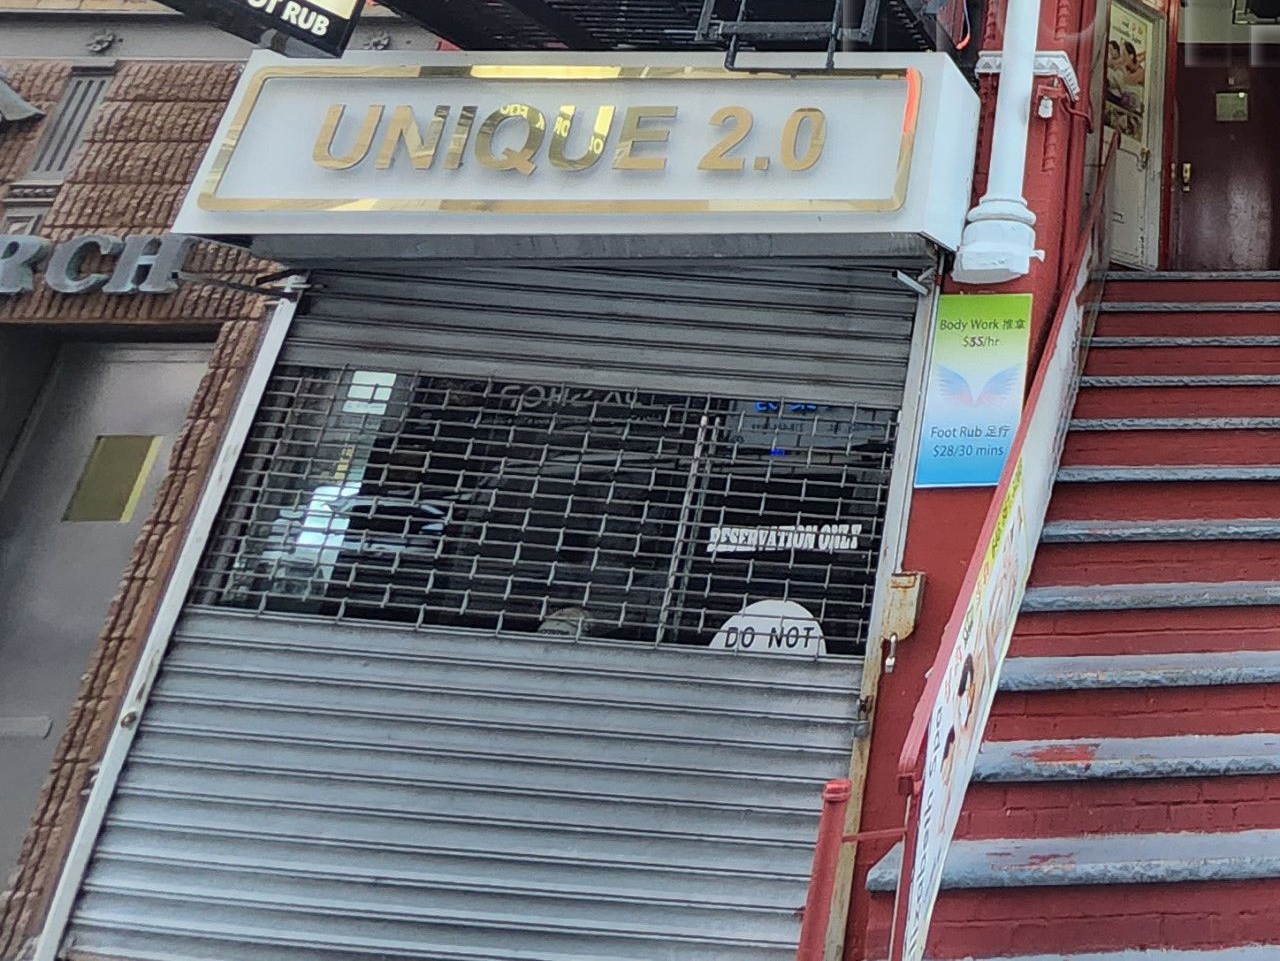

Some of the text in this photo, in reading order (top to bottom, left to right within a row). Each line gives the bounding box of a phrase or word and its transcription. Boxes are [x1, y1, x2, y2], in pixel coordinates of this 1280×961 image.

[281, 1, 332, 39] RUB
[312, 103, 823, 176] UNIQUE 2.0
[940, 319, 967, 332] Body
[970, 319, 999, 331] Work
[930, 426, 957, 438] Foot
[959, 426, 983, 438] Rub
[932, 444, 1004, 458] $28/30 mins
[725, 626, 815, 649] DO NOT
